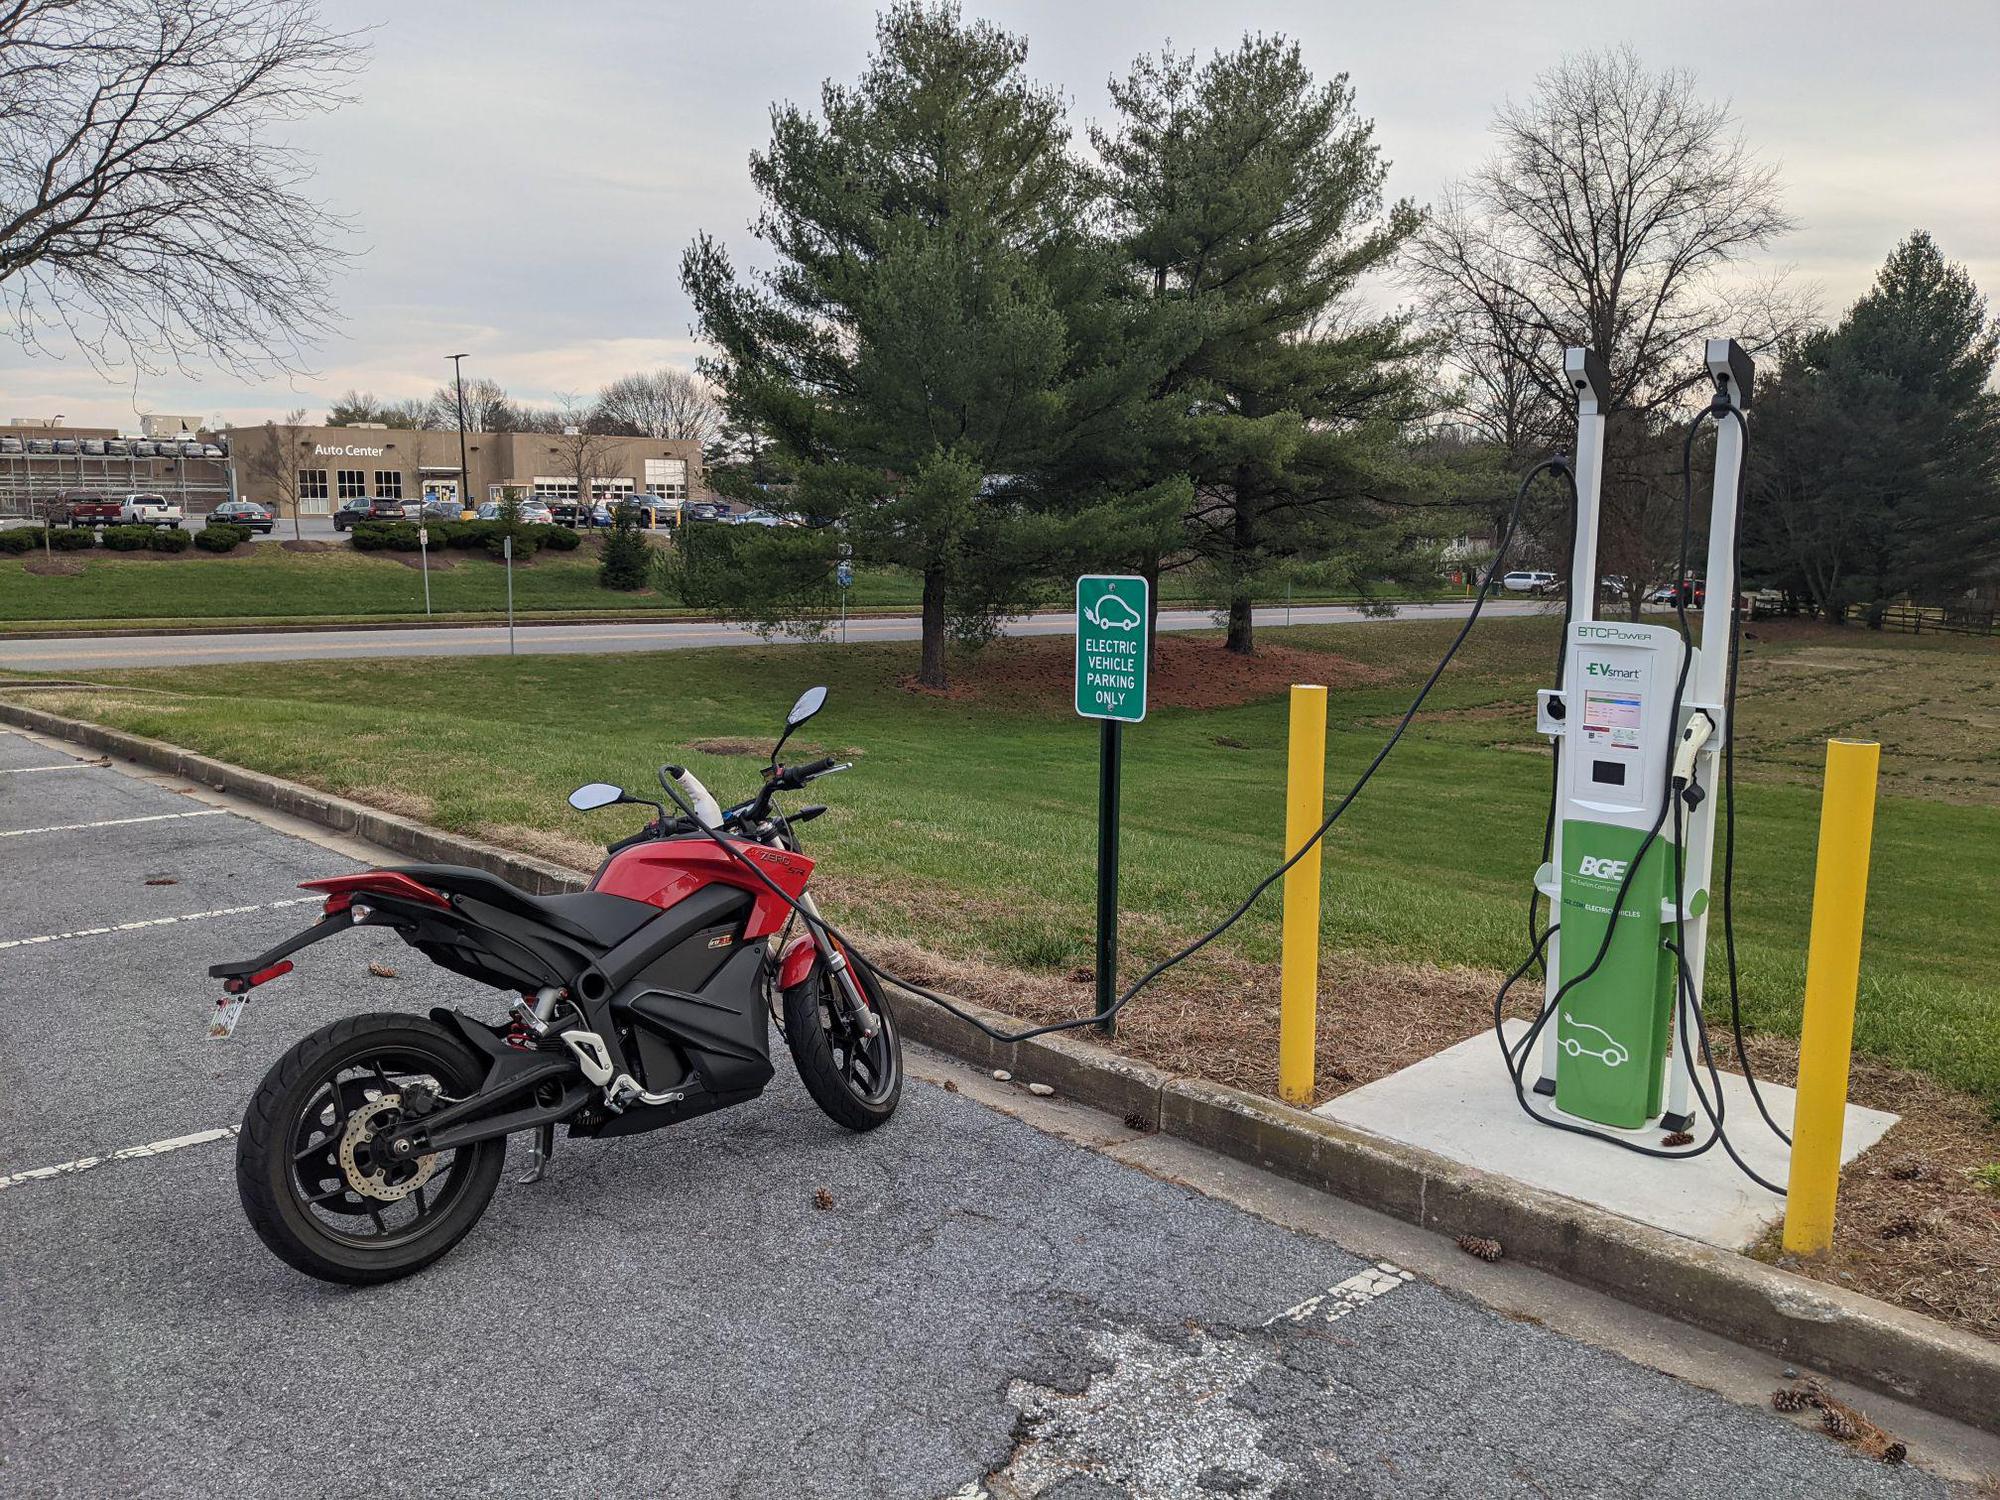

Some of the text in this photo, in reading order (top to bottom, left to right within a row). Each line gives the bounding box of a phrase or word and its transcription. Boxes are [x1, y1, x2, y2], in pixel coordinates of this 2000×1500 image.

[315, 444, 383, 457] Auto Center
[1085, 638, 1137, 654] ELECTRIC
[1088, 655, 1135, 672] VEHICLE
[1087, 673, 1135, 689] PARKING
[1095, 690, 1126, 705] ONLY
[760, 850, 790, 865] ZERO
[1579, 855, 1628, 880] BGE
